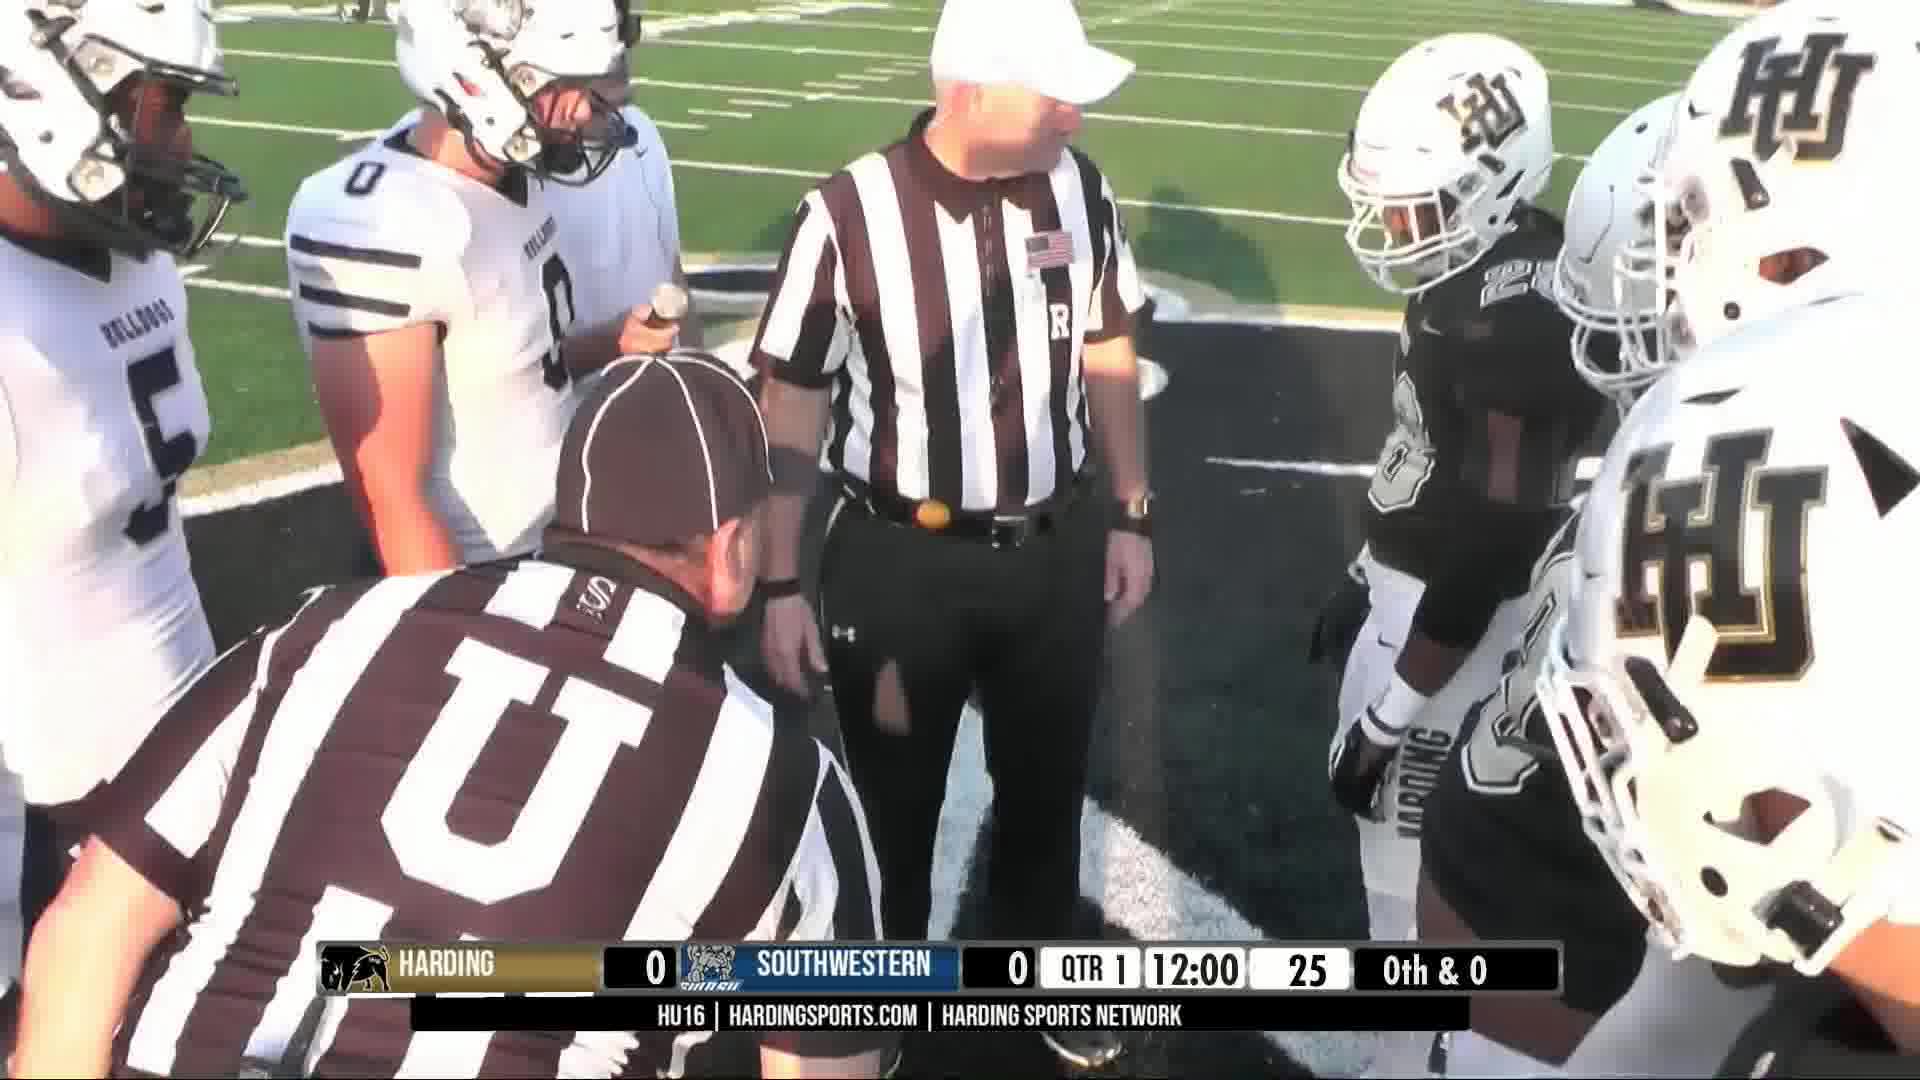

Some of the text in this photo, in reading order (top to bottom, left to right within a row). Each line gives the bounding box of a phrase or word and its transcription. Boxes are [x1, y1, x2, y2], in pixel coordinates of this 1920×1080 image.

[344, 160, 386, 197] 0
[100, 297, 175, 348] BULLDOGS
[1050, 304, 1070, 339] R
[125, 346, 198, 545] 5
[380, 636, 653, 905] U
